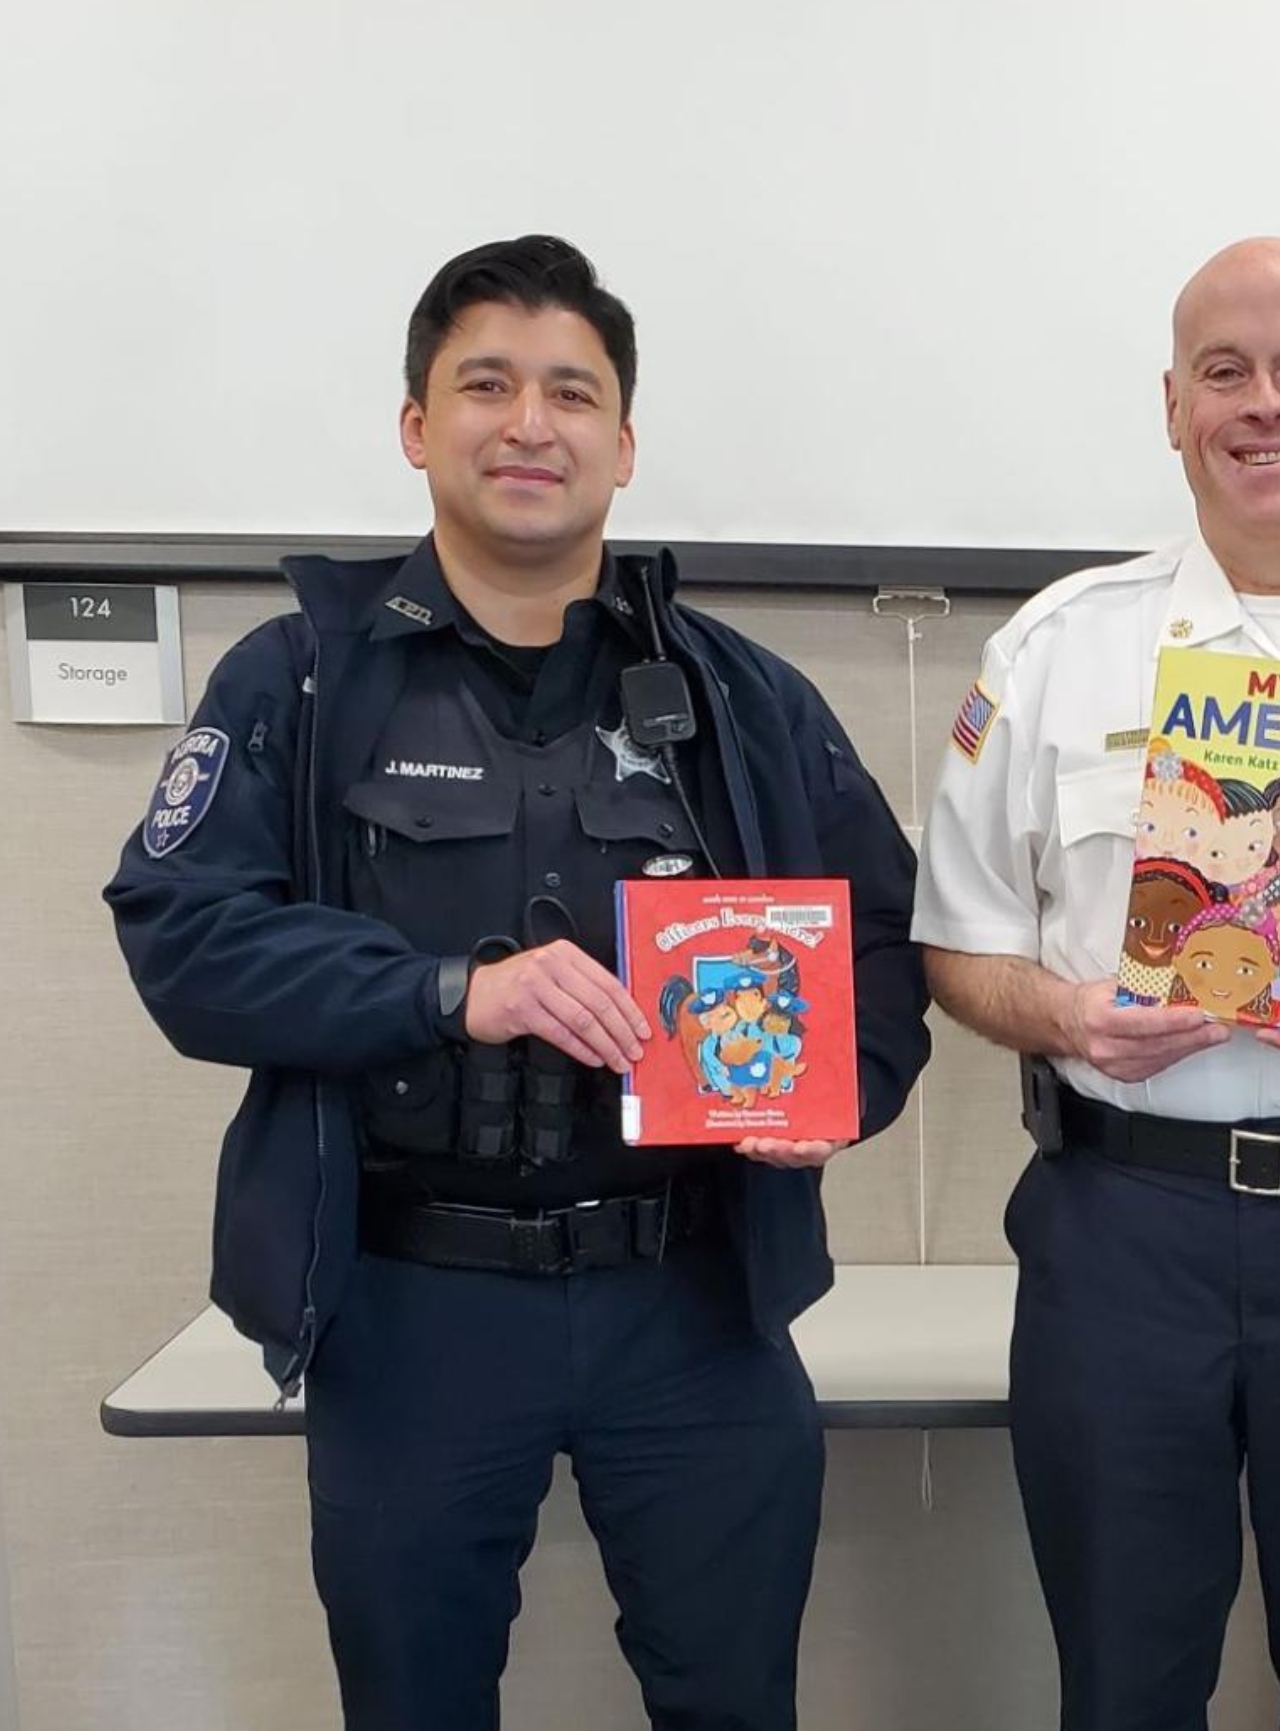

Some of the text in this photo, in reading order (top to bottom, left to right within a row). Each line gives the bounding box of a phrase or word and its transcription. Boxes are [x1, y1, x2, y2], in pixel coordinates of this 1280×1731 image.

[70, 597, 112, 618] 124
[58, 662, 128, 686] Storage
[1204, 749, 1278, 771] Karen Katz
[151, 805, 192, 829] POLICE
